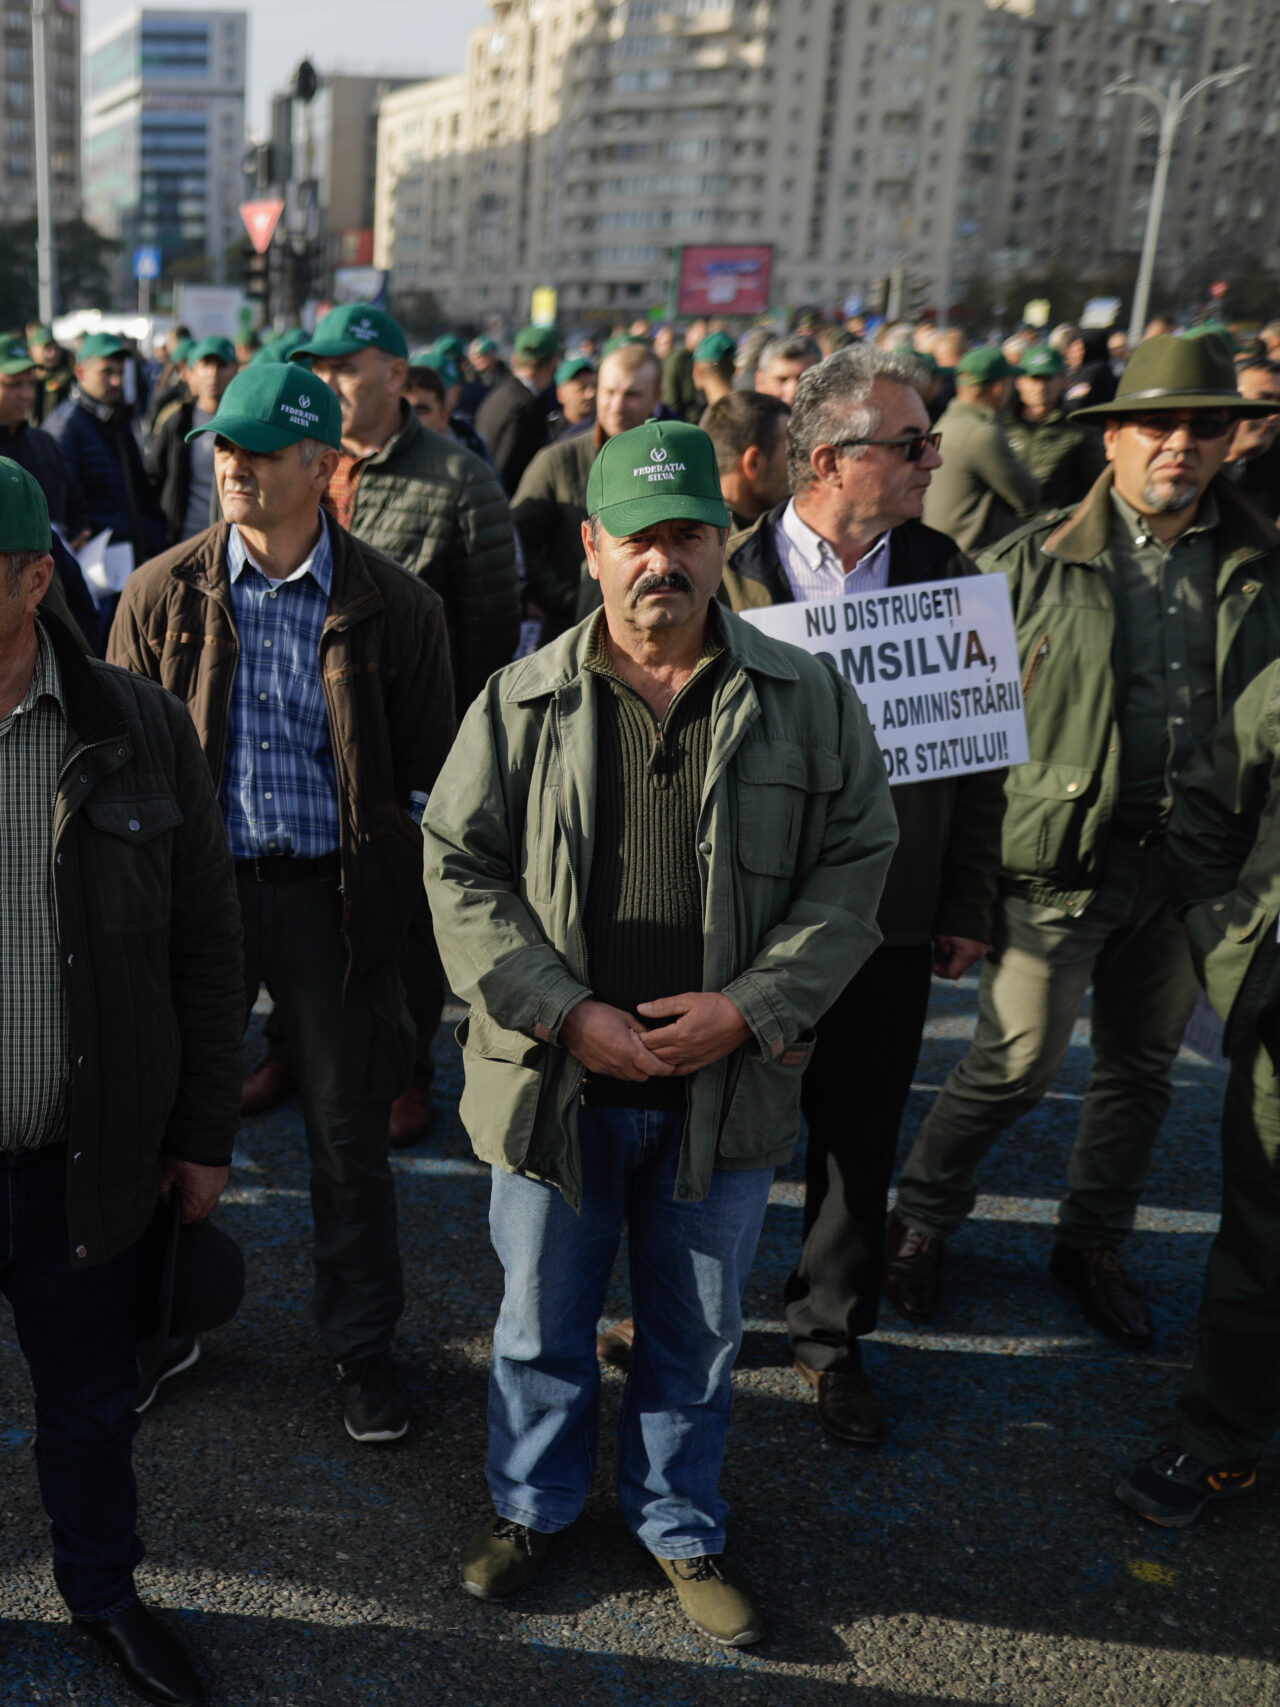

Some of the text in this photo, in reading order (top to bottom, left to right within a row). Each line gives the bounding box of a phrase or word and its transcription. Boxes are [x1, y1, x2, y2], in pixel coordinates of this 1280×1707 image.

[648, 473, 675, 482] SILVA
[804, 586, 962, 637] NU DISTRUGEȚI
[814, 629, 997, 685] MSILVA,
[882, 678, 1021, 730] ADMINISTRĂRII
[881, 731, 1009, 778] OR STATULUI!
